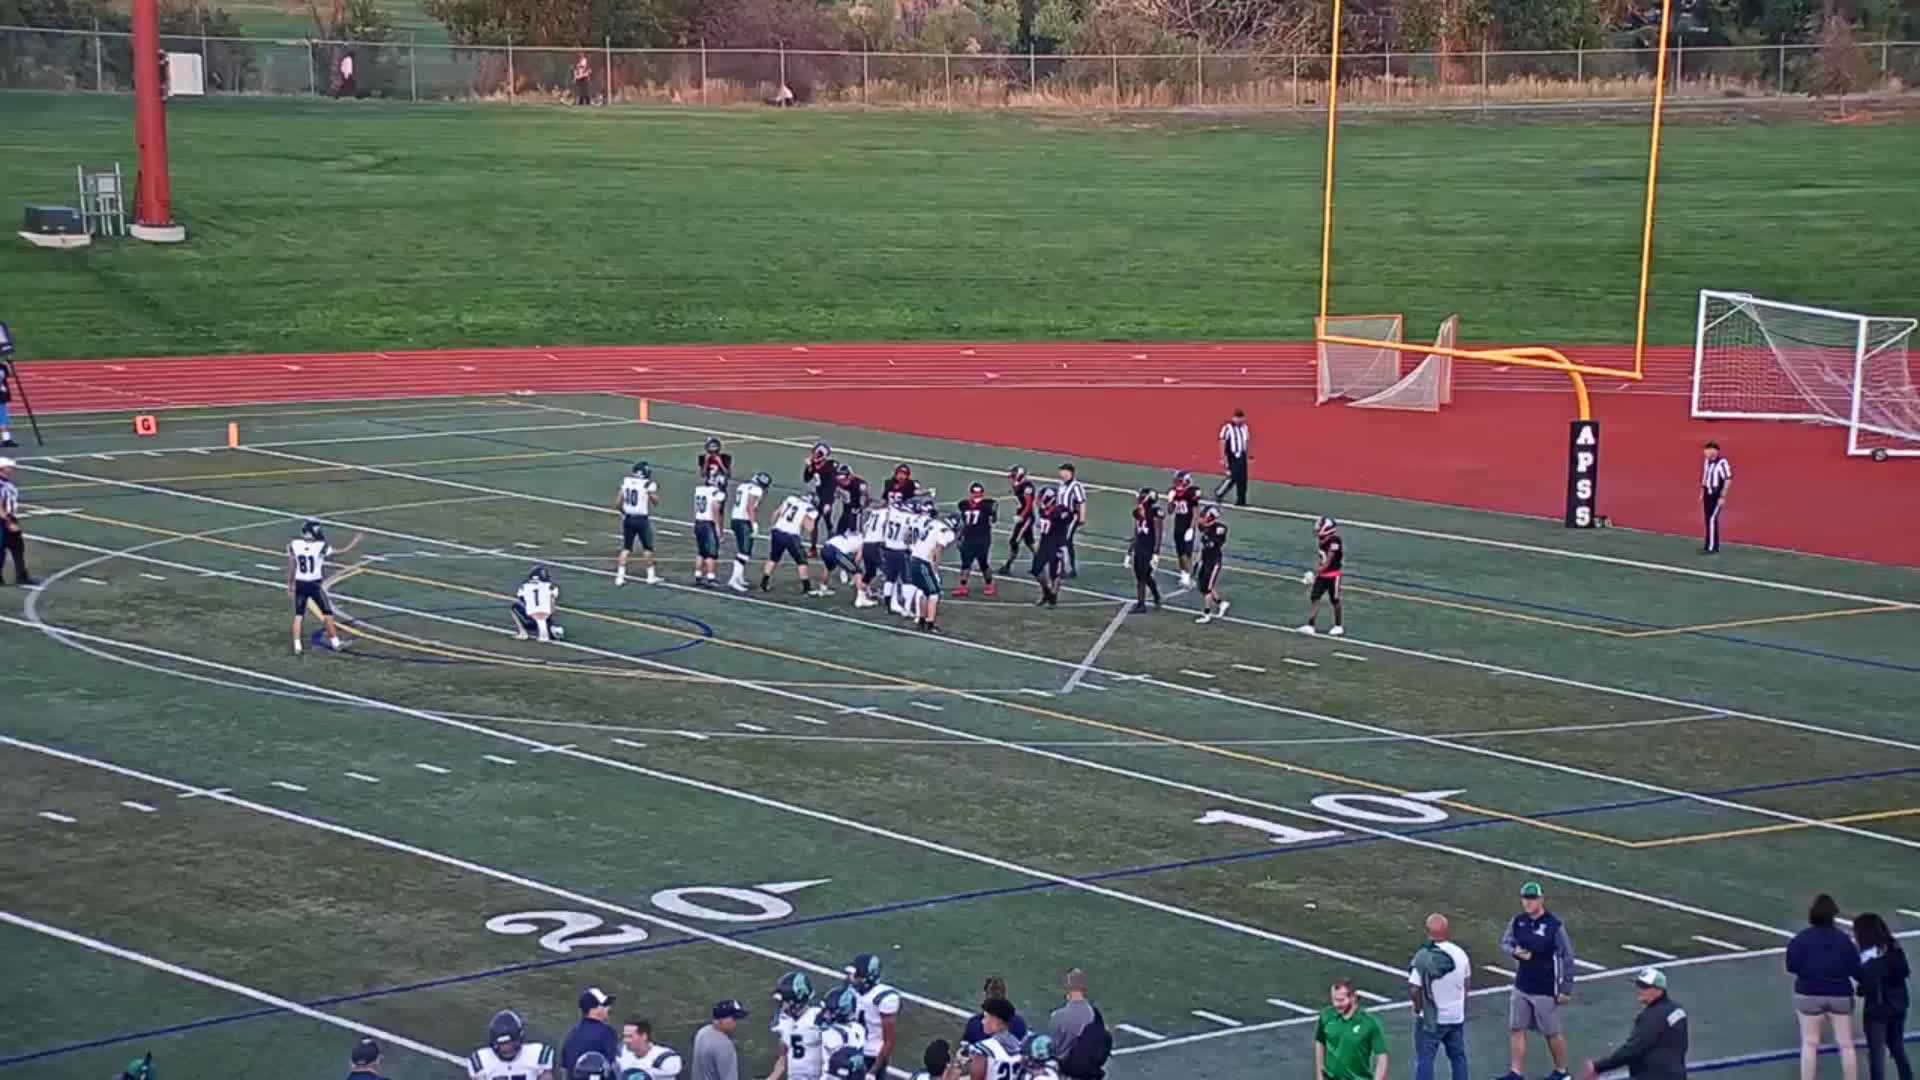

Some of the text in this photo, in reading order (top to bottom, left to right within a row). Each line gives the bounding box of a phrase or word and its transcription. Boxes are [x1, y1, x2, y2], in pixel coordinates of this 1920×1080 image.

[142, 418, 151, 431] G
[1575, 425, 1596, 526] APSS
[785, 502, 799, 522] 73
[964, 510, 981, 525] 77
[298, 555, 315, 574] 81
[533, 588, 540, 607] 1
[790, 1034, 805, 1059] 5
